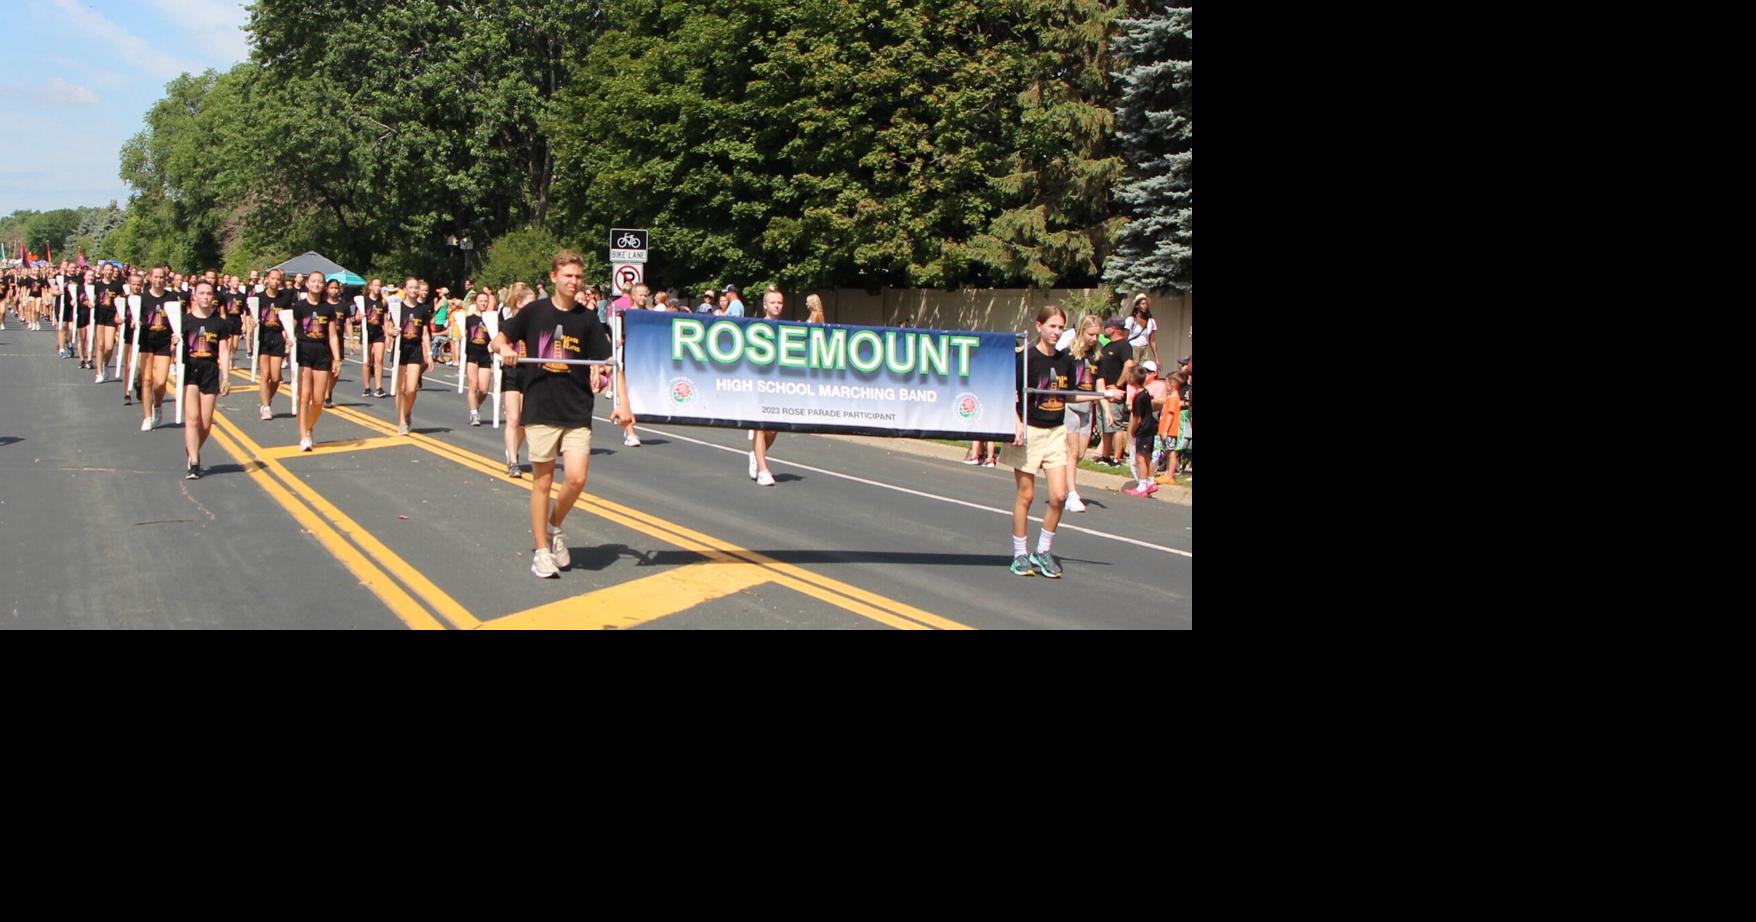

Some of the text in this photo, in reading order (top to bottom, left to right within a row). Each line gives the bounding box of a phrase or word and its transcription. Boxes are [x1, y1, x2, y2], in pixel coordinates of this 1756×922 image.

[611, 251, 626, 259] BIKE
[671, 318, 980, 377] ROSEMOUNT
[715, 378, 753, 392] HIGH
[757, 380, 816, 396] SCHOOL
[818, 384, 896, 401] MARCHING
[899, 388, 938, 402] BAND
[761, 406, 897, 421] 2023 ROSE PARADE PARTICIPANT
